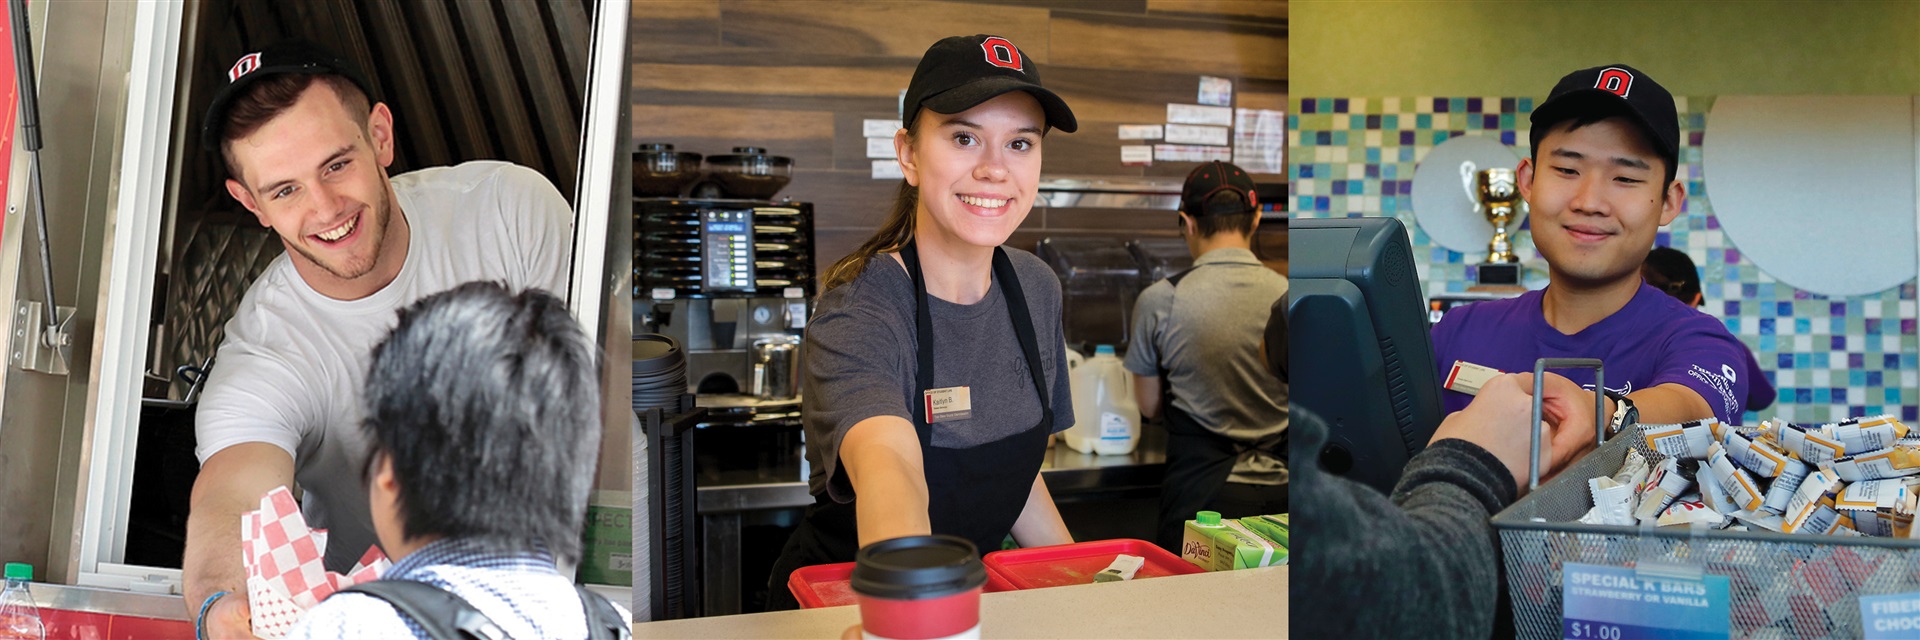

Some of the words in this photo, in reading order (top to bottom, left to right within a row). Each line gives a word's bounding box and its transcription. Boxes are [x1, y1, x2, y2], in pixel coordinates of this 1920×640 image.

[980, 36, 1023, 71] O
[1593, 67, 1634, 98] O
[1571, 572, 1640, 590] SPECIAL
[1661, 581, 1707, 596] BARS
[1571, 586, 1642, 601] STRAWBERRY
[1644, 594, 1661, 604] OR
[1663, 595, 1709, 608] VANILLA
[1571, 621, 1621, 640] $1.00
